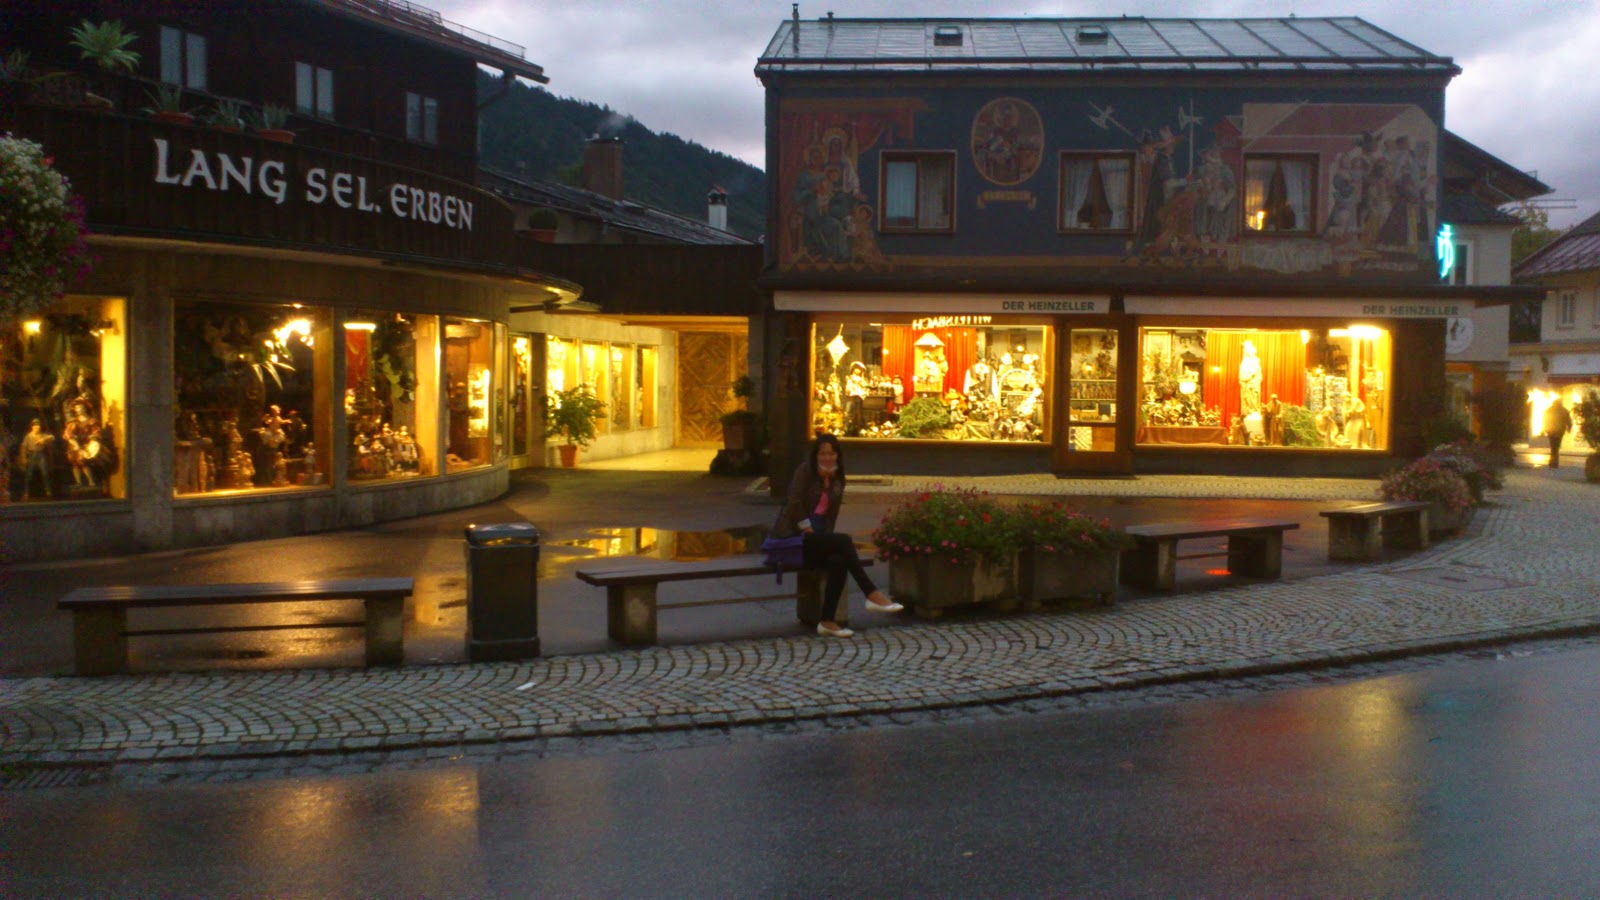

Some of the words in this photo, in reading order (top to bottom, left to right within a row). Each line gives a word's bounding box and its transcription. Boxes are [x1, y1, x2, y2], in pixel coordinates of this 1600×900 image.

[153, 138, 288, 205] LANG
[306, 168, 381, 214] SEL.
[390, 183, 474, 232] ERBEN
[1002, 301, 1025, 311] DER
[1028, 301, 1095, 312] HEINZELLER
[1363, 305, 1385, 315] DER
[1390, 305, 1458, 316] HEINZELLER
